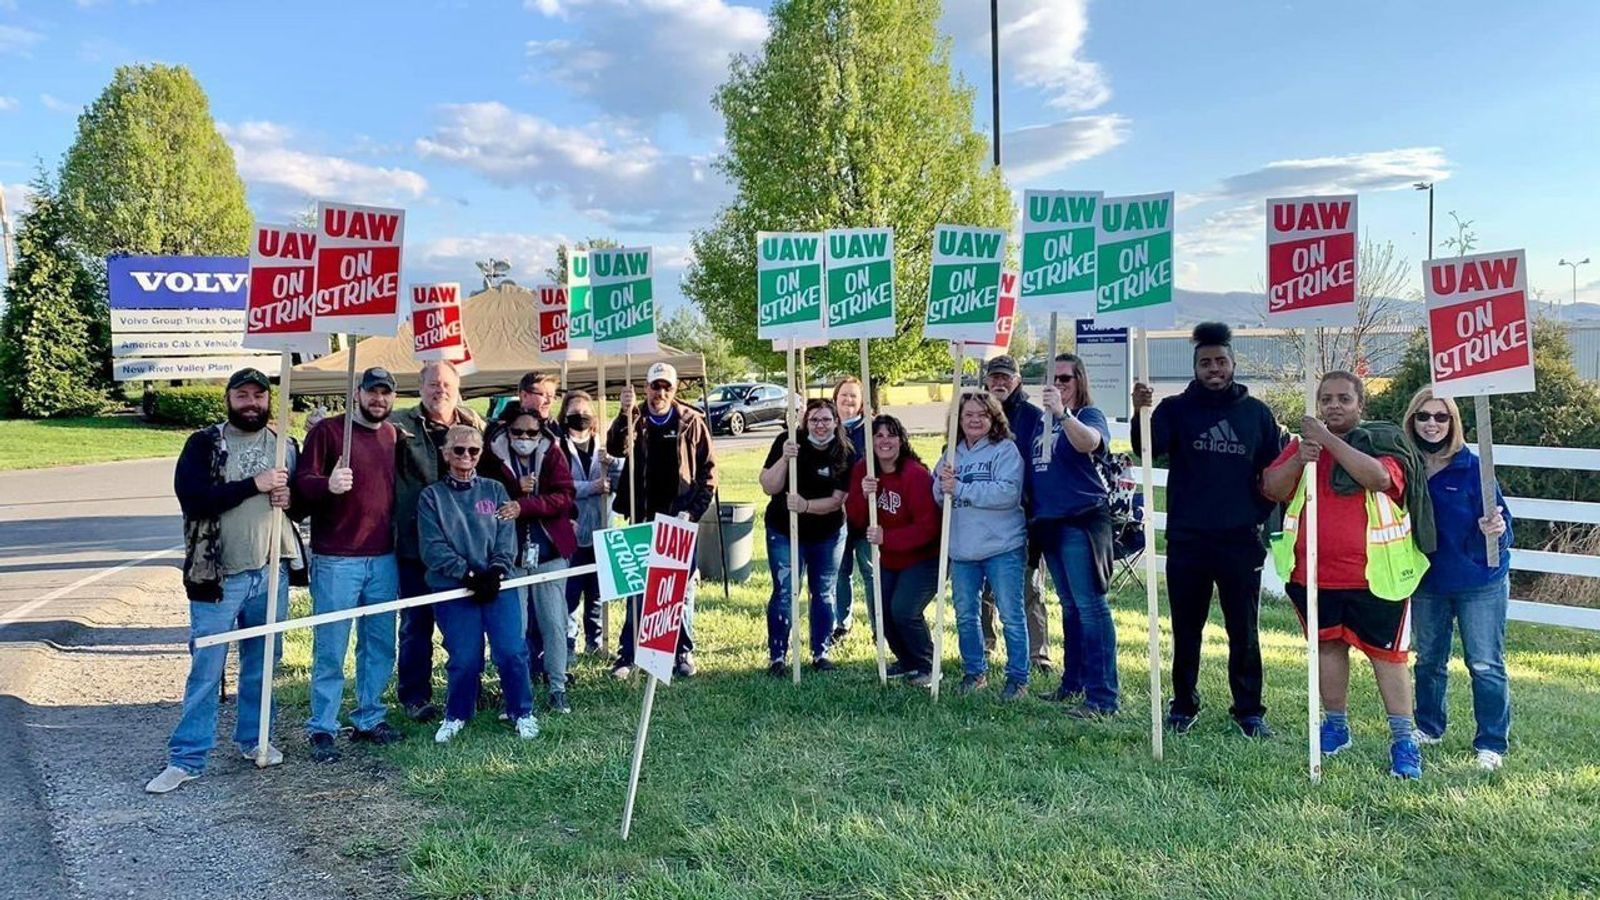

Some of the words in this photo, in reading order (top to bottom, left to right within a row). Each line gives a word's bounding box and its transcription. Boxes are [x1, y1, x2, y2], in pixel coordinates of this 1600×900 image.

[325, 208, 399, 242] UAW
[1030, 196, 1097, 223] UAW
[1102, 199, 1169, 232] UAW
[1274, 201, 1351, 232] UAW
[763, 237, 818, 261] UAW
[830, 233, 888, 259] UAW
[939, 230, 1002, 258] UAW
[1043, 231, 1073, 262] ON
[1119, 240, 1149, 274] ON
[1292, 239, 1326, 273] ON
[340, 250, 373, 281] ON
[594, 252, 649, 277] UAW
[845, 266, 870, 294] ON
[949, 266, 977, 293] ON
[1022, 251, 1096, 295] STRIKE
[1431, 257, 1518, 295] UAW
[129, 271, 248, 292] VOLV
[273, 269, 305, 299] ON
[317, 272, 398, 314] STRIKE
[414, 287, 456, 304] UAW
[541, 288, 568, 305] UA
[610, 284, 634, 310] ON
[776, 268, 800, 295] ON
[1098, 258, 1171, 310] STRIKE
[1270, 259, 1354, 310] STRIKE
[249, 294, 315, 331] STRIK
[426, 308, 445, 329] ON
[761, 285, 820, 325] STRIKE
[829, 282, 891, 325] STRIKE
[928, 285, 998, 322] STRIKE
[120, 316, 148, 325] Volvo
[151, 316, 182, 326] Group
[186, 316, 216, 325] Trucks
[415, 320, 461, 350] STRIKE
[595, 299, 653, 340] STRIKE
[1456, 301, 1494, 338] ON
[121, 340, 169, 349] Americas
[172, 339, 190, 348] Cab
[204, 339, 238, 348] Vehicle
[1435, 319, 1527, 379] STRIKE
[122, 365, 146, 374] New
[148, 364, 173, 373] River
[176, 364, 205, 374] Valley
[208, 363, 233, 372] Plant
[1193, 437, 1246, 455] adidas
[655, 522, 695, 564] UAW
[606, 531, 645, 592] STRIKE
[657, 572, 677, 607] ON
[640, 602, 684, 643] STRIKE
